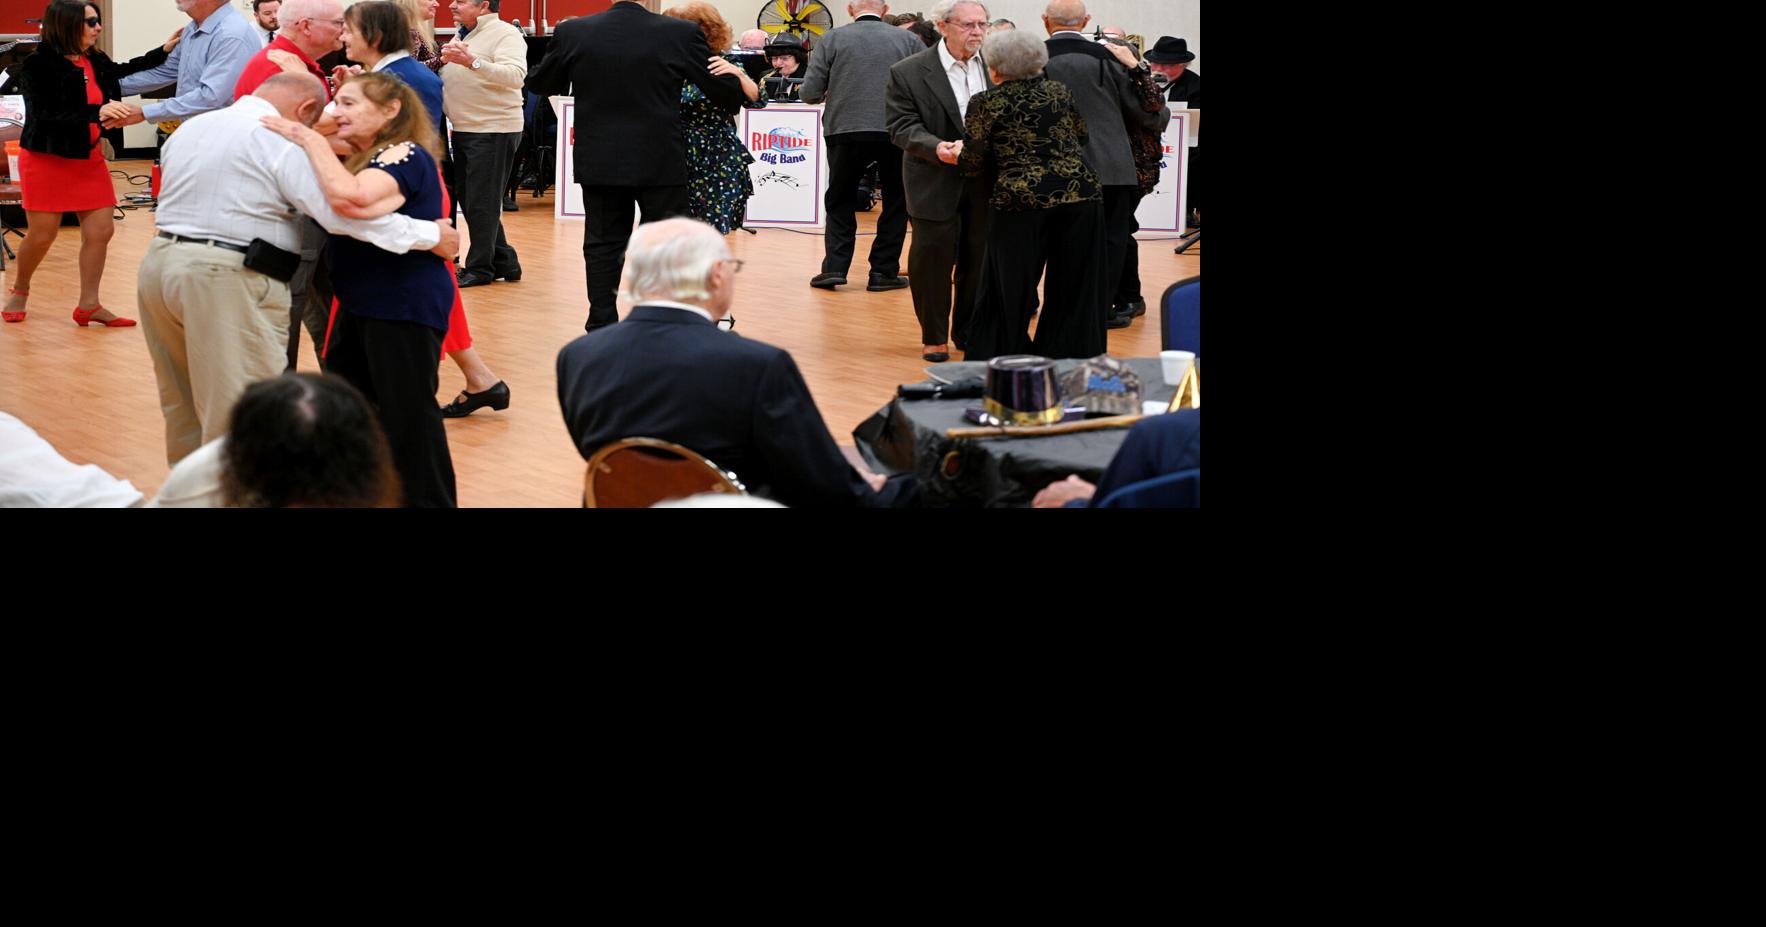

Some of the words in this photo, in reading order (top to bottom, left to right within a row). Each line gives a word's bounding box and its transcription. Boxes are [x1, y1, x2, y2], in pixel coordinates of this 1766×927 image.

[752, 132, 813, 151] RIPTIDE
[759, 152, 777, 165] Big
[780, 153, 806, 164] Band
